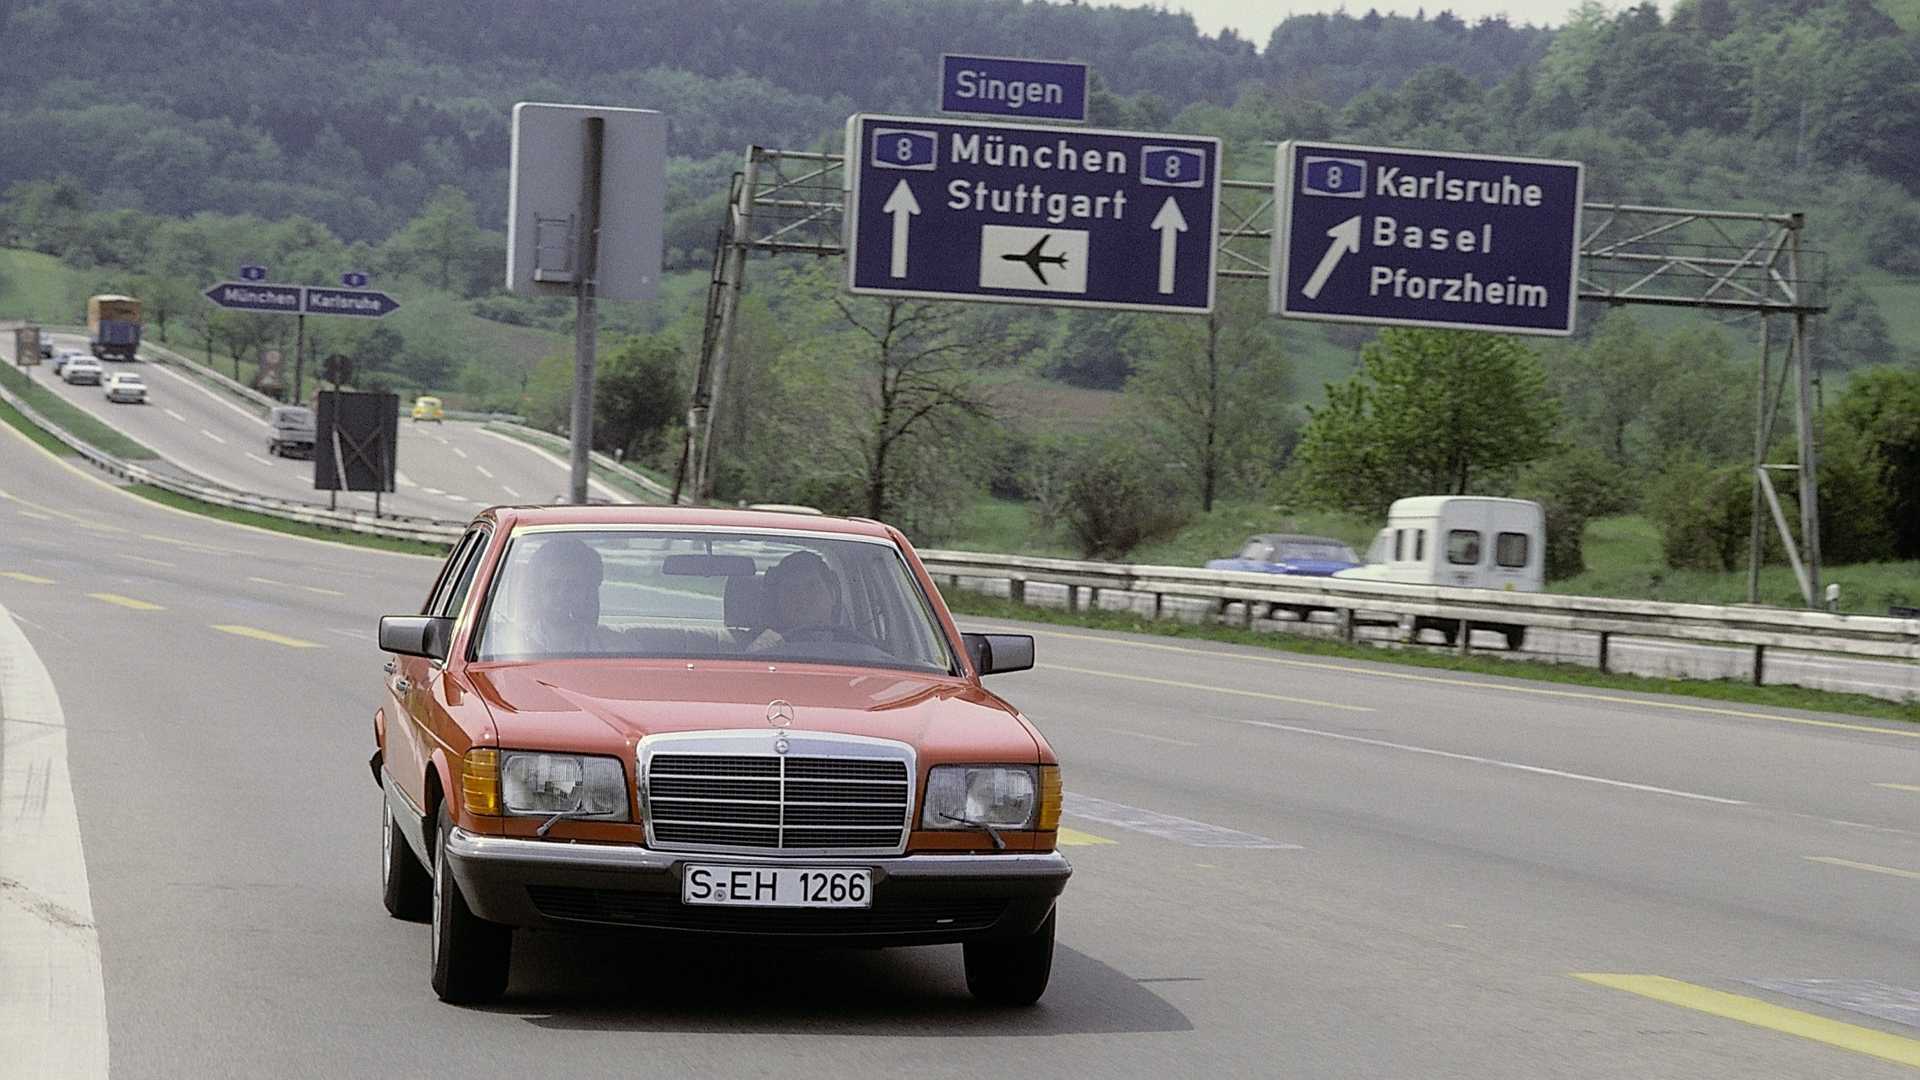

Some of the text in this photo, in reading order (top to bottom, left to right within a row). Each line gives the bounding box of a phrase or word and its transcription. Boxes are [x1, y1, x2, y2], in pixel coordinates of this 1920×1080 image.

[956, 70, 1063, 109] Singen
[896, 138, 913, 162] 8
[951, 132, 1128, 174] München
[1164, 155, 1182, 179] 8
[1326, 166, 1343, 189] 8
[1377, 166, 1543, 207] Karlsruhe
[947, 179, 1128, 224] Stuttgart
[1373, 216, 1493, 254] Basel
[1370, 266, 1549, 308] Pforzheim
[690, 869, 866, 902] S-EH 1266
